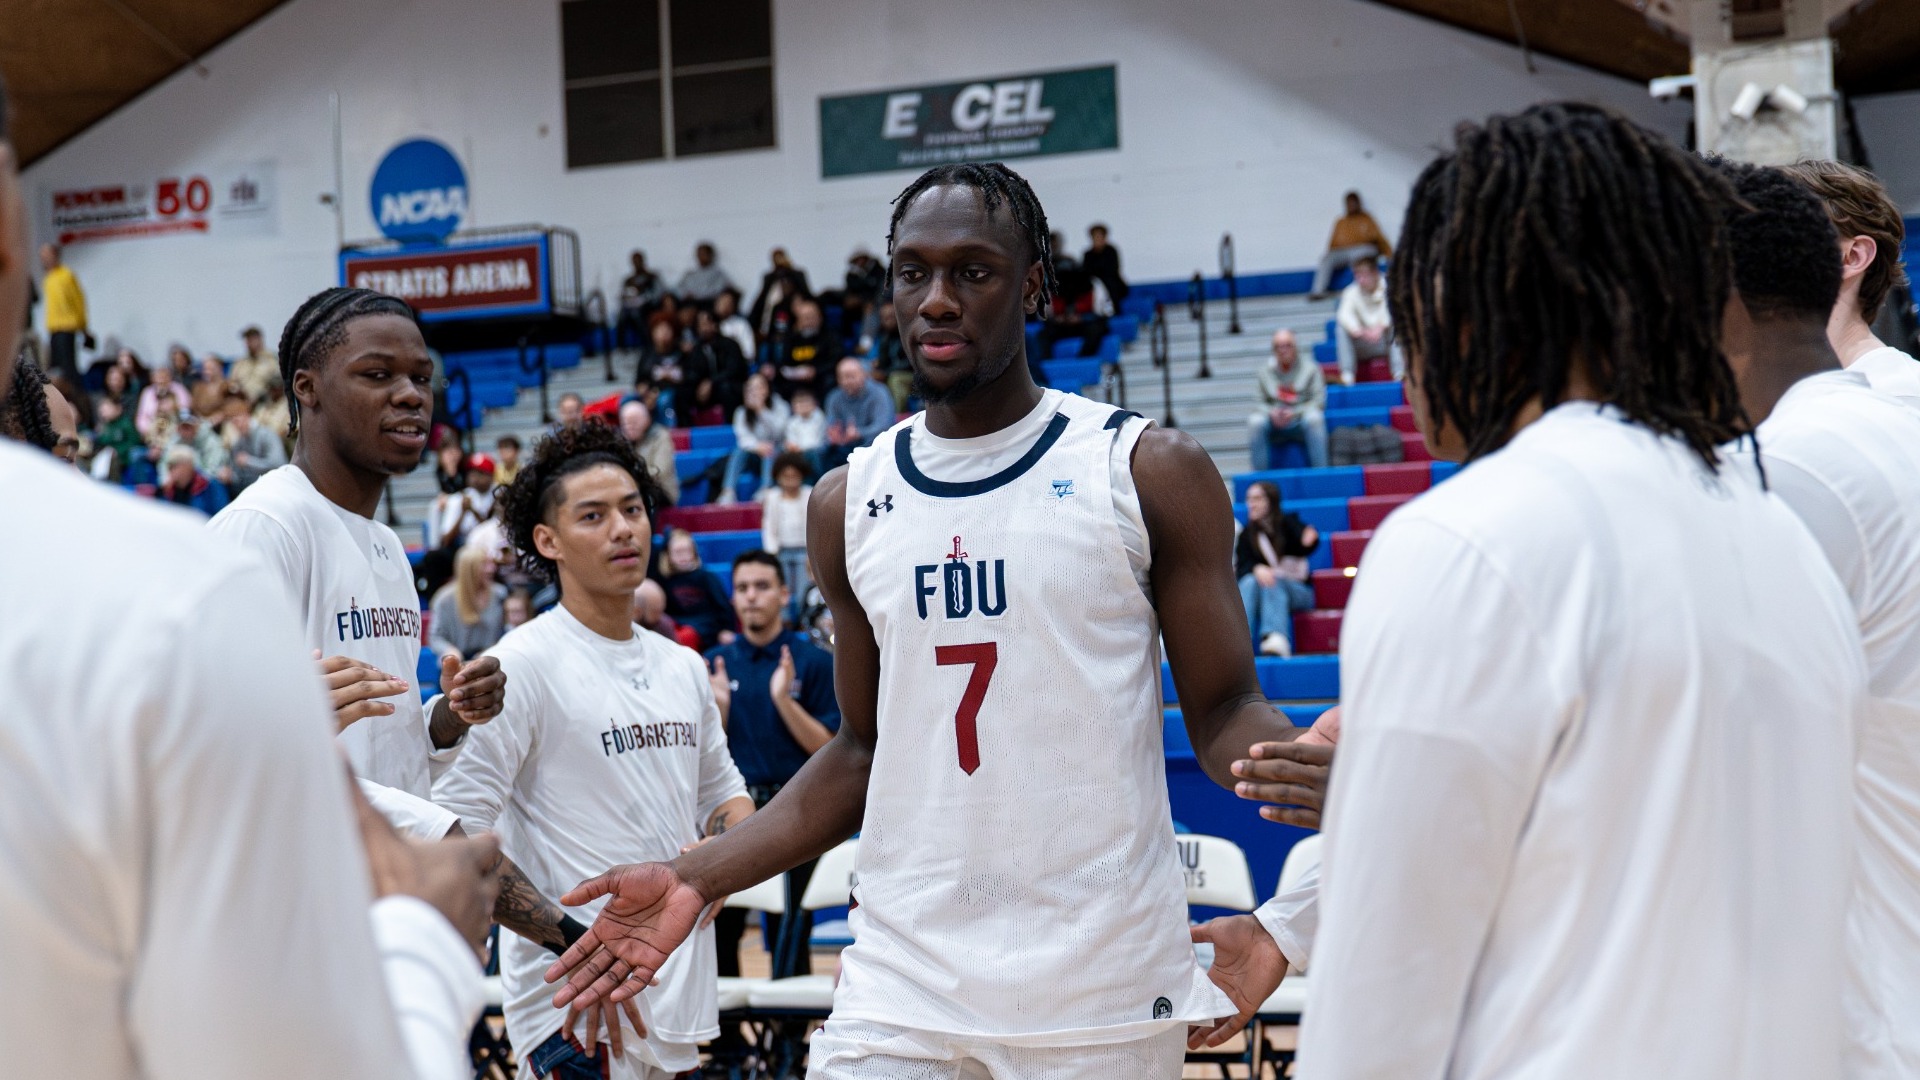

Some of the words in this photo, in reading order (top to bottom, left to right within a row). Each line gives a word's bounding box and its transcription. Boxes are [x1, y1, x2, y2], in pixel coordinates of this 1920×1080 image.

[882, 79, 1056, 139] ECEL
[156, 176, 210, 216] 50
[380, 186, 467, 227] NCAA
[355, 265, 449, 298] STRATIS
[452, 258, 531, 296] ARENA
[914, 558, 1007, 621] FDU
[935, 641, 998, 776] 7
